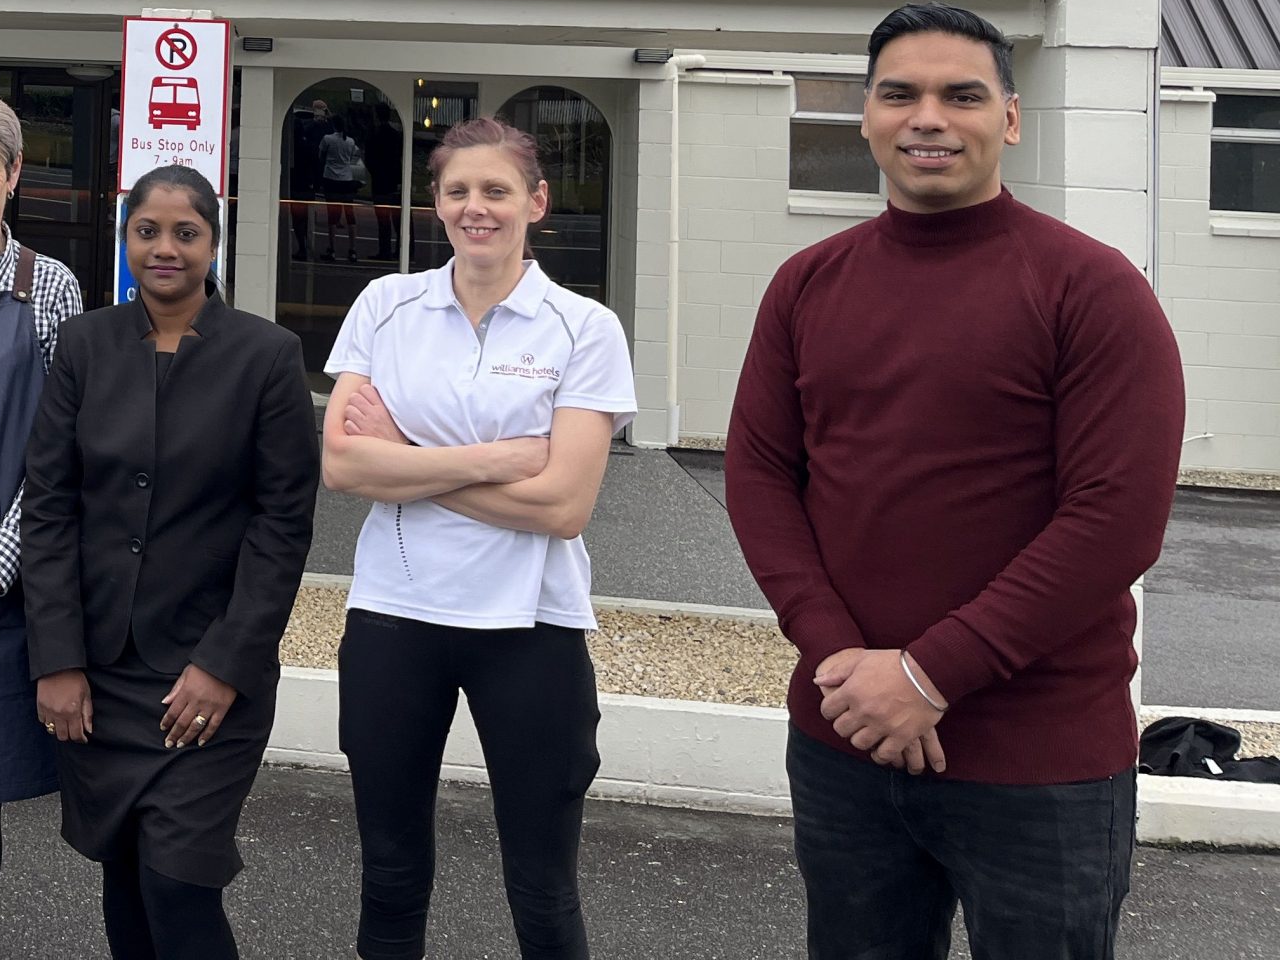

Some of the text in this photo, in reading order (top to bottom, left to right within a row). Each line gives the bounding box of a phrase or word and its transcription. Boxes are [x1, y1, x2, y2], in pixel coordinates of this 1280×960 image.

[131, 137, 215, 155] Bus Stop Only
[154, 154, 160, 165] 7
[172, 155, 193, 166] 9am
[491, 364, 531, 374] williams
[532, 366, 560, 377] hotels
